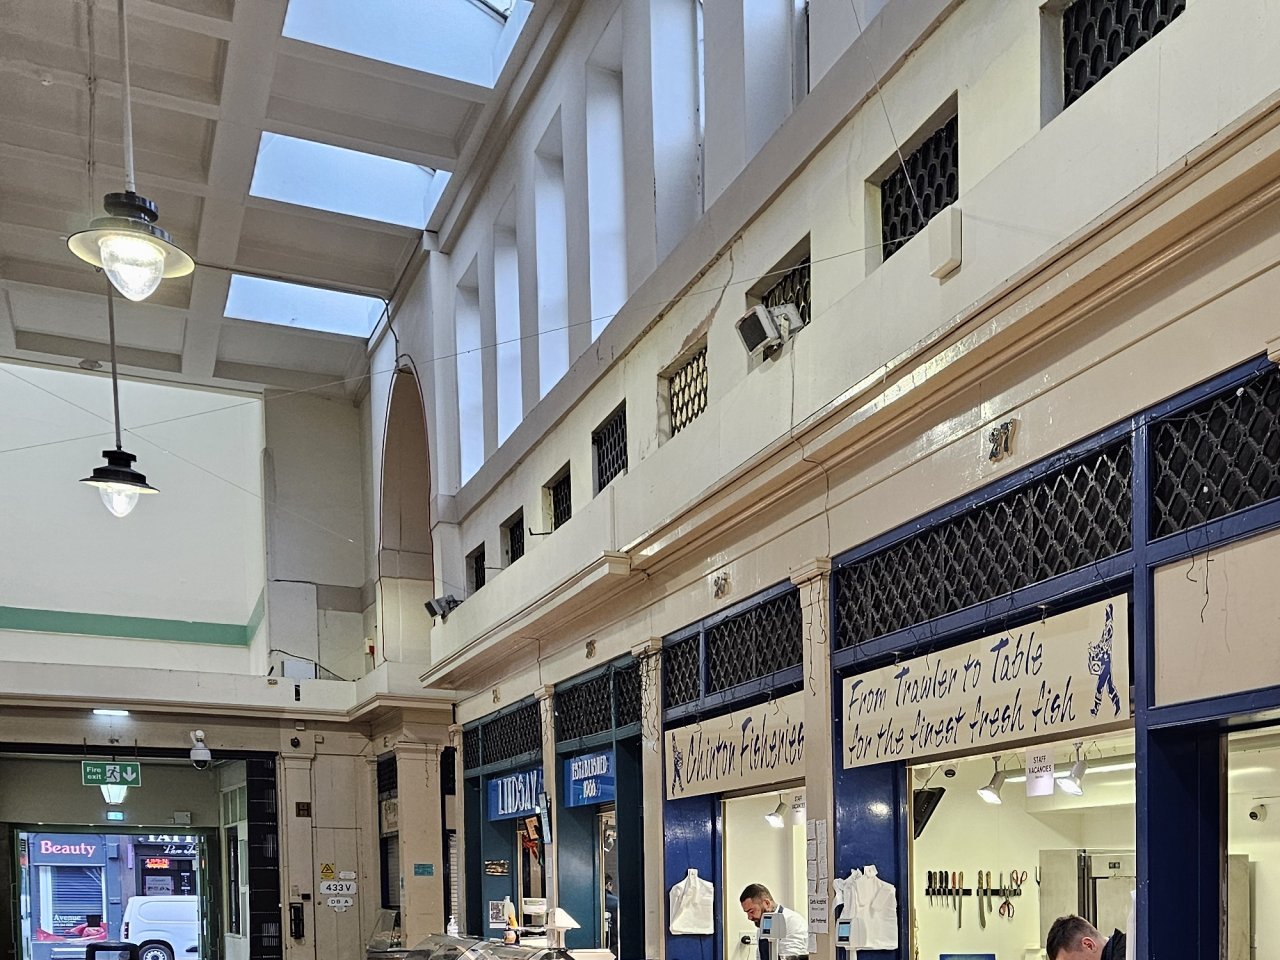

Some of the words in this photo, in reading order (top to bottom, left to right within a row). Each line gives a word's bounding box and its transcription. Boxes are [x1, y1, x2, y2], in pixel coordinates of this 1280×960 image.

[848, 679, 887, 721] From
[894, 659, 957, 707] Trawler
[963, 653, 982, 693] to
[990, 632, 1043, 683] Table
[848, 723, 872, 765] for
[877, 717, 904, 759] the
[909, 709, 966, 754] finest
[969, 688, 1025, 744] fresh
[1031, 676, 1076, 732] fish
[686, 731, 736, 784] Chirton
[740, 713, 805, 776] Fisheries
[1033, 755, 1046, 764] STAFF
[1028, 764, 1052, 774] VACANCIES
[40, 840, 96, 857] Beauty
[326, 883, 344, 892] 433
[345, 884, 352, 892] V
